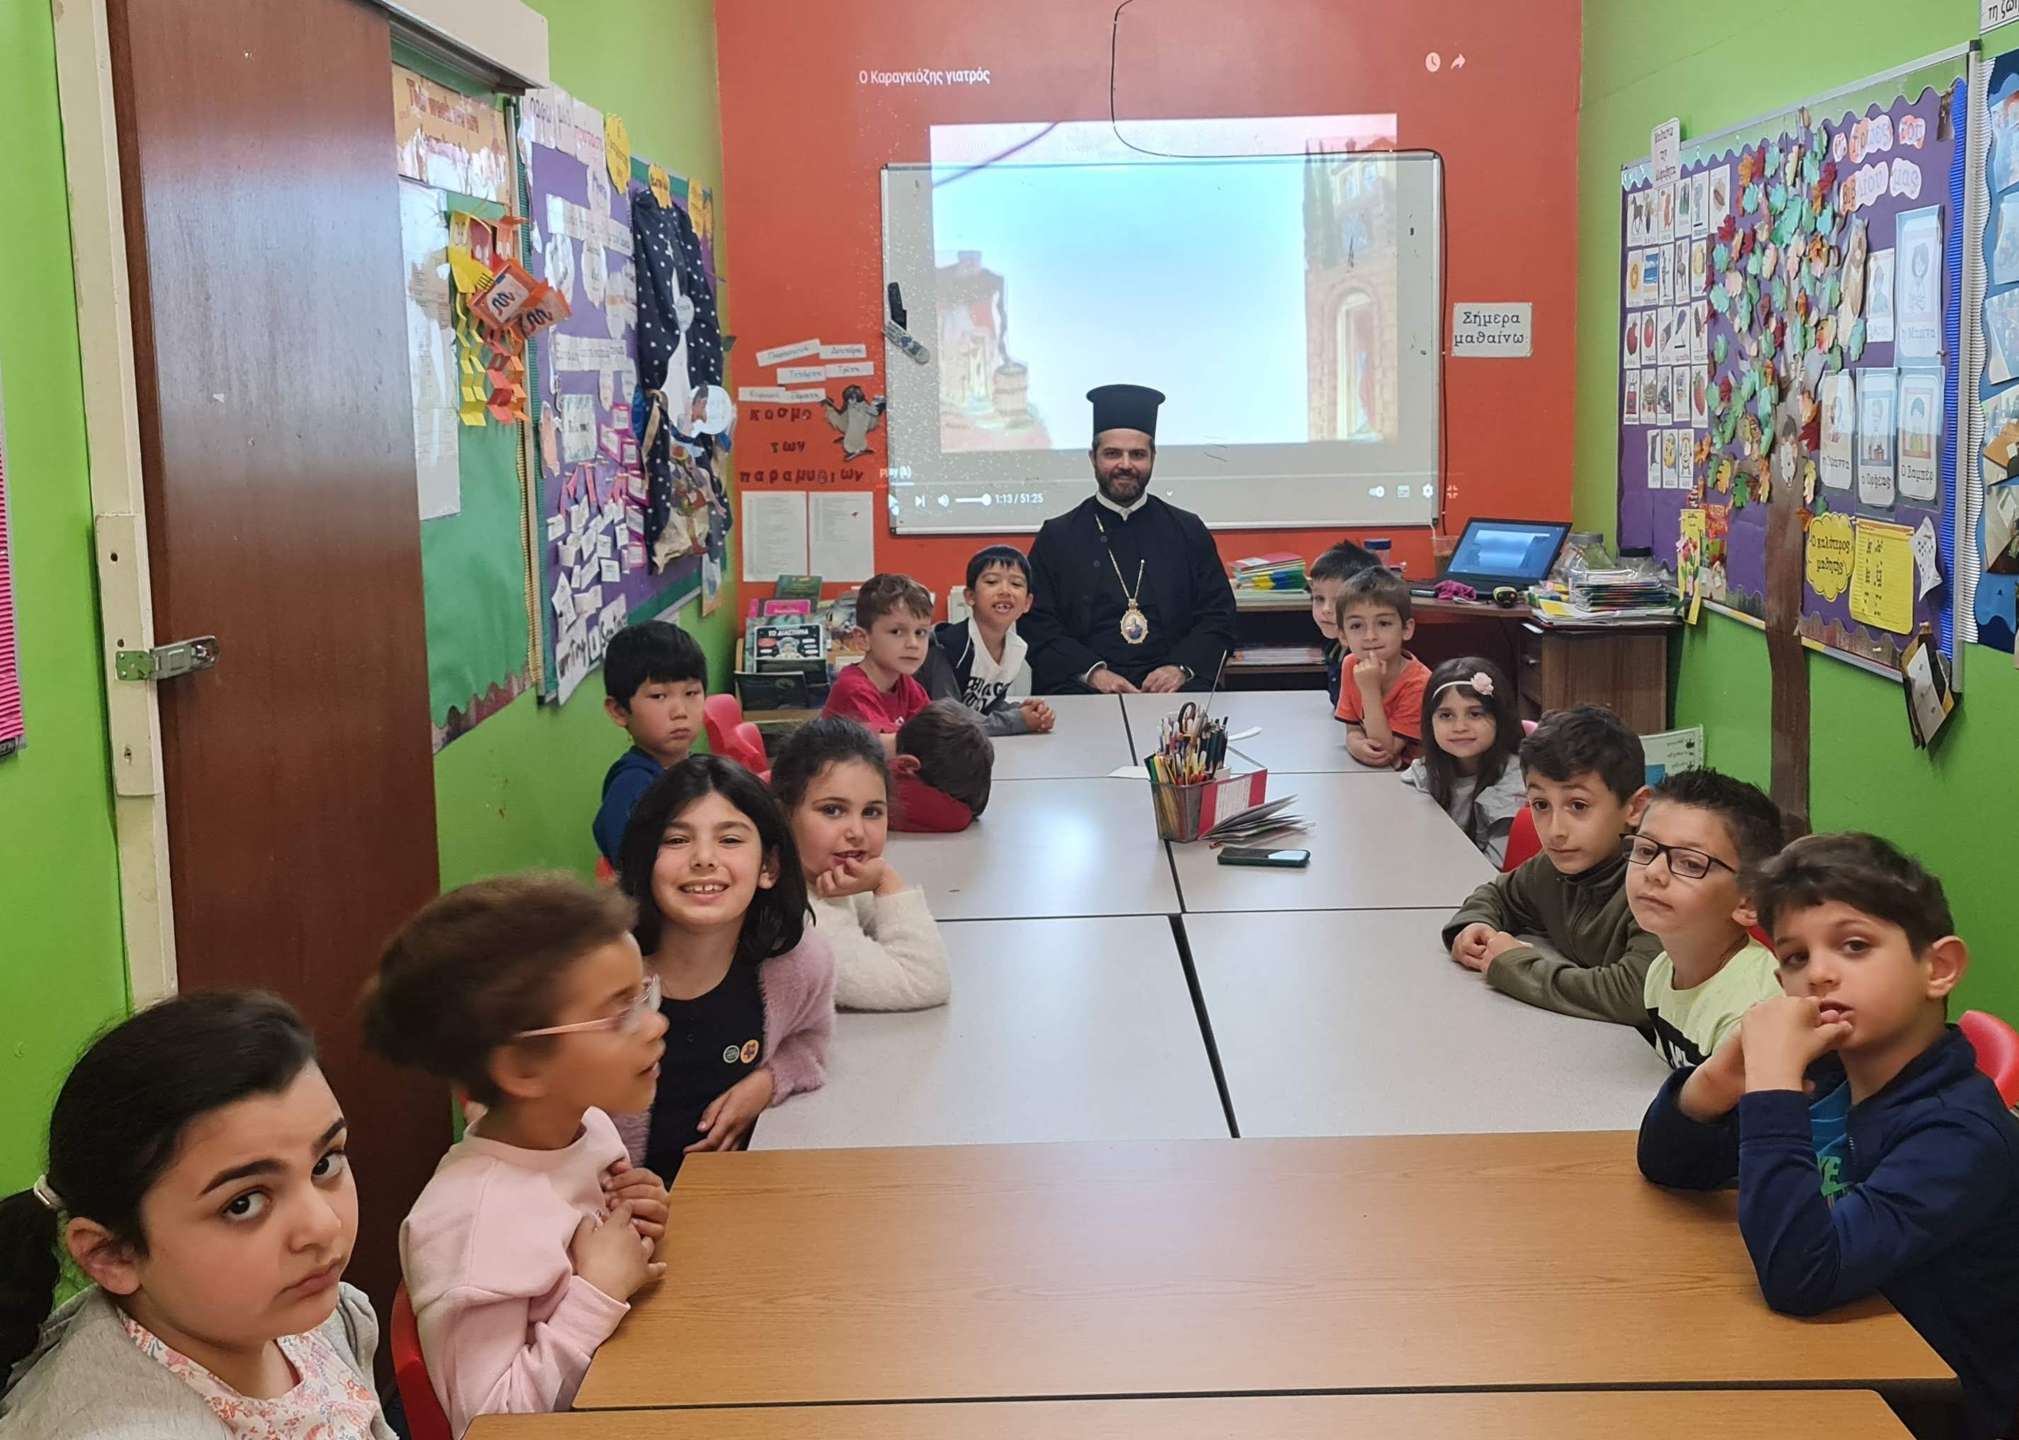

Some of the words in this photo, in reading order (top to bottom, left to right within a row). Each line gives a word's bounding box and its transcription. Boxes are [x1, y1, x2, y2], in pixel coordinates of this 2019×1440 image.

[858, 69, 868, 84] Ο
[870, 68, 943, 86] Καραγκιόζης
[945, 66, 991, 85] γιατρός
[1462, 311, 1521, 328] Σήμερα
[1454, 331, 1525, 347] μαθαίνω
[995, 494, 1013, 504] 1:13
[1020, 493, 1044, 504] 51:25
